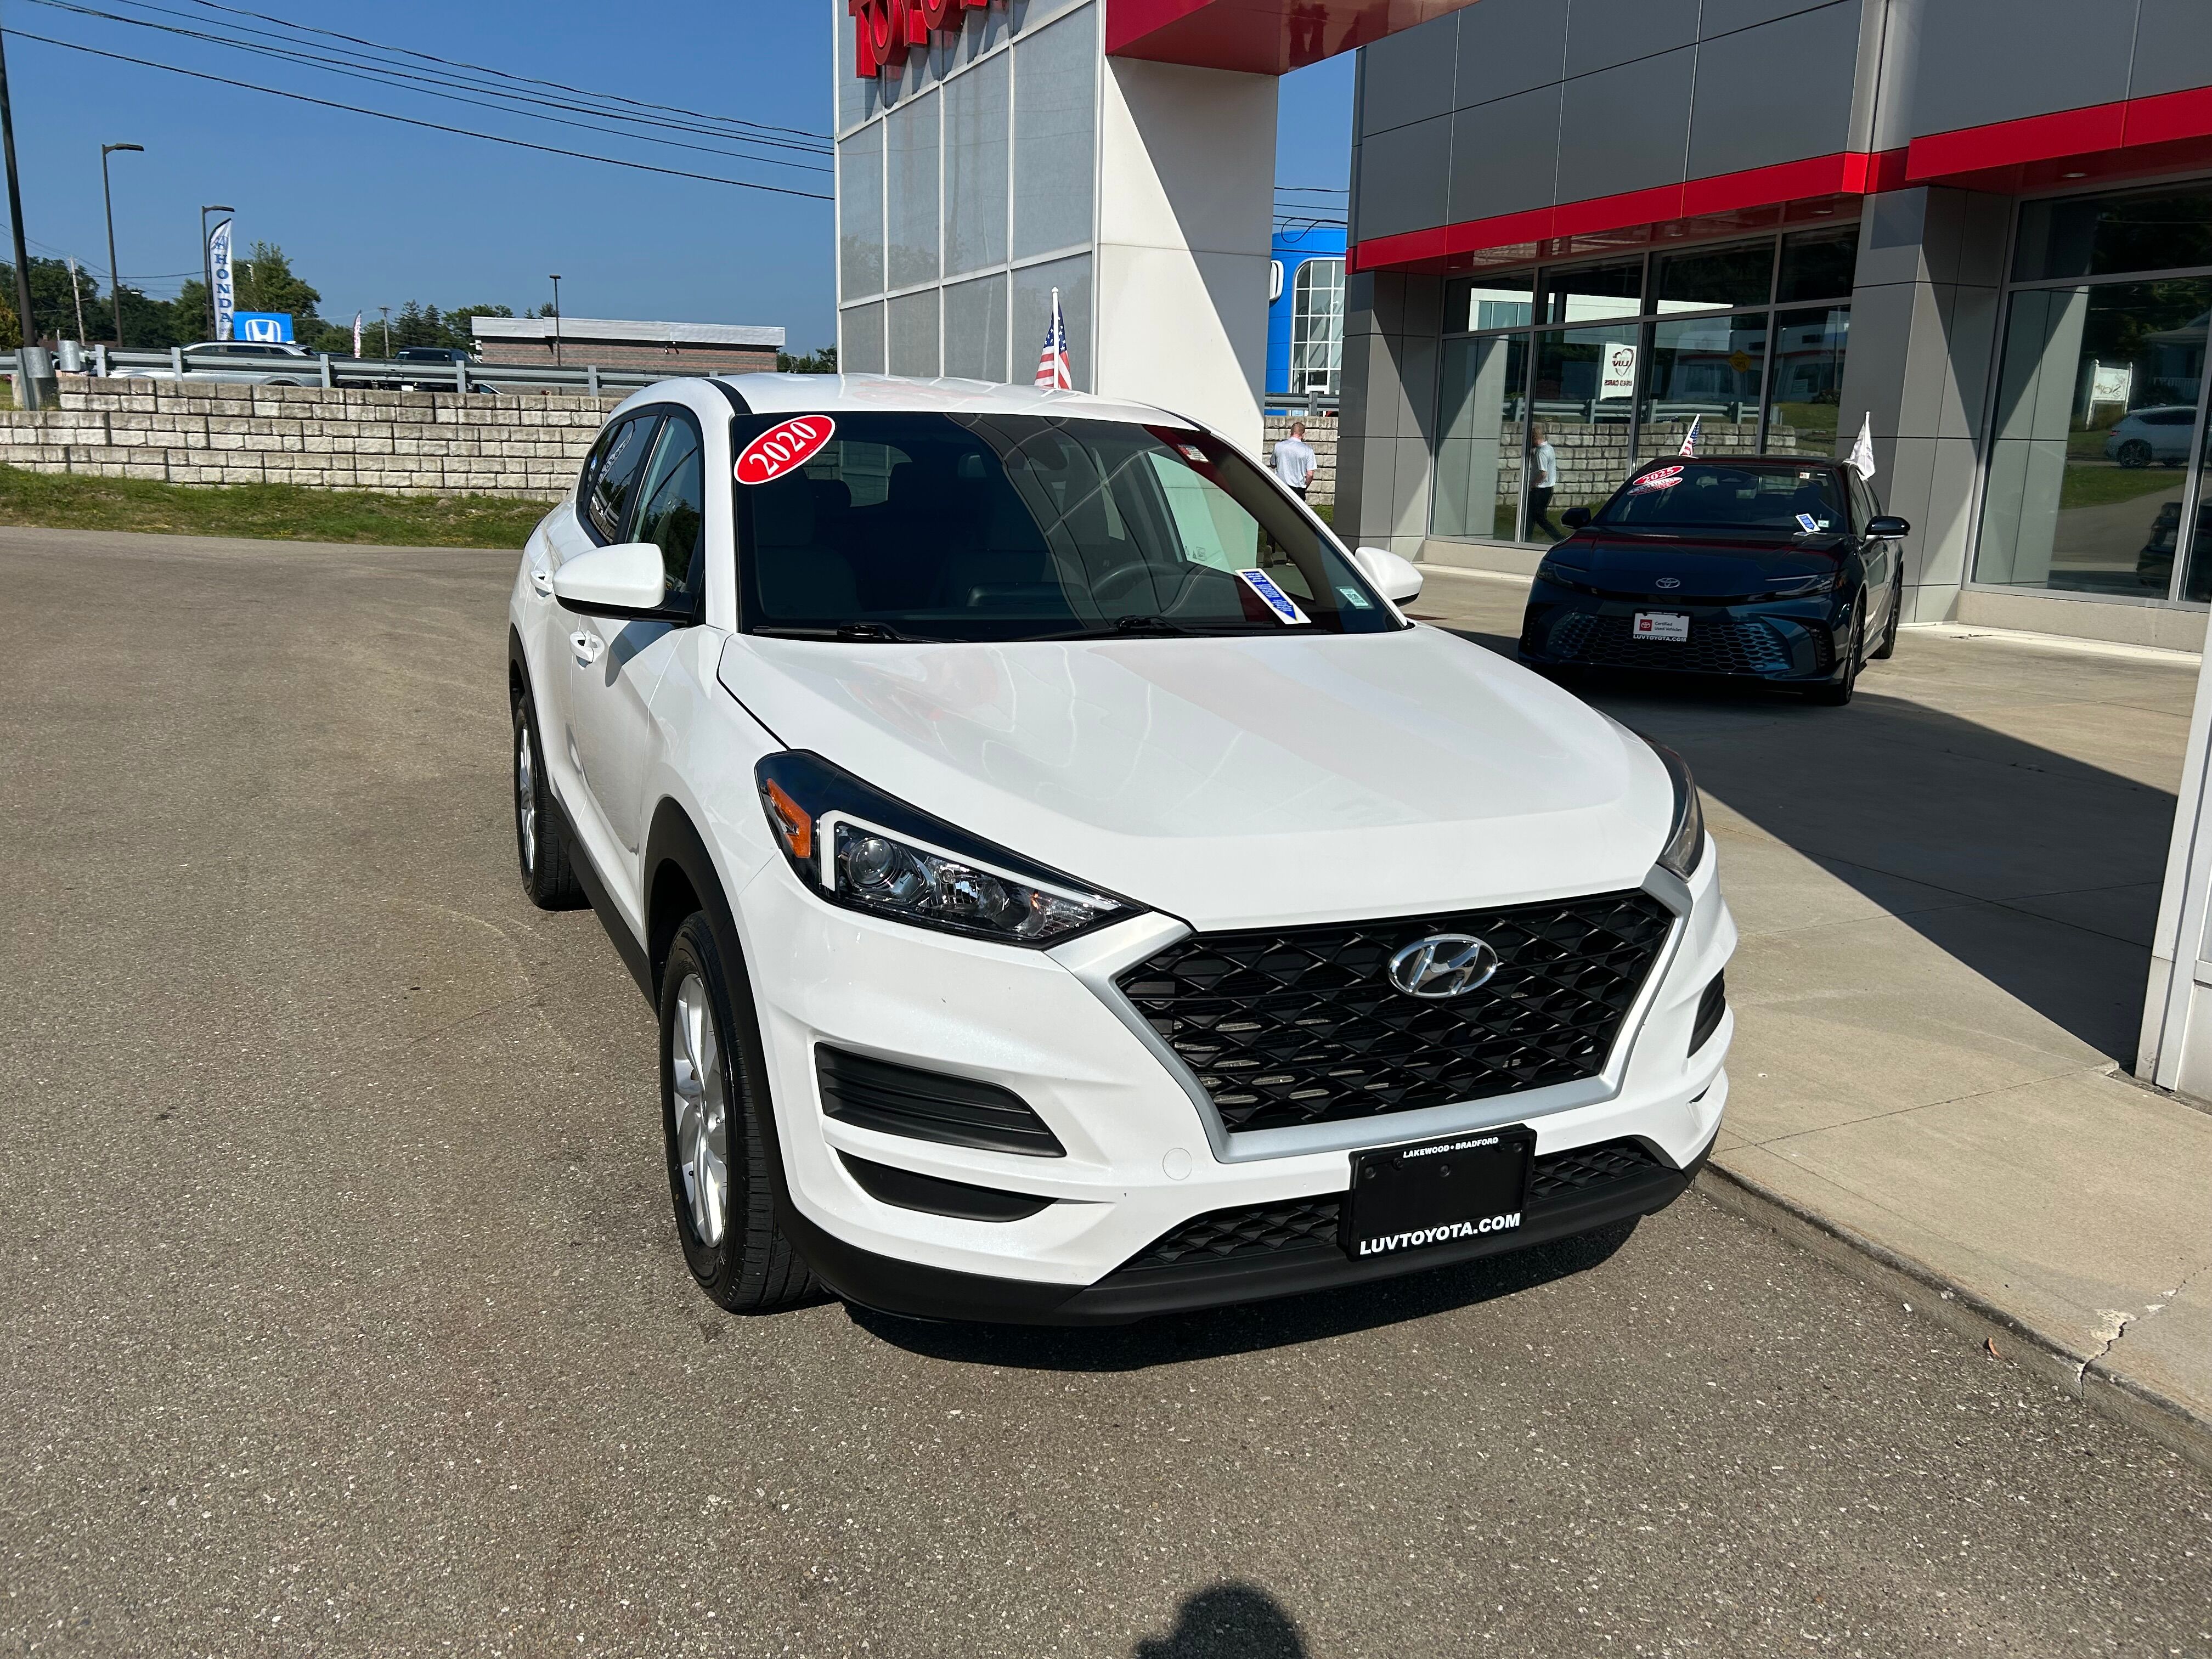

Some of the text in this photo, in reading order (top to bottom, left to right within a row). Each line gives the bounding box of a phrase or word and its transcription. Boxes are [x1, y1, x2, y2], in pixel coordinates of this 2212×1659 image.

[214, 253, 234, 323] HONDA
[748, 421, 817, 476] 2020
[1642, 468, 1674, 483] 2025
[1633, 634, 1686, 642] LUVTOYOTA.COM
[1403, 1137, 1499, 1158] LAKEWOOD BRADFORD
[1359, 1212, 1521, 1255] LUVTOYOTA.COM
